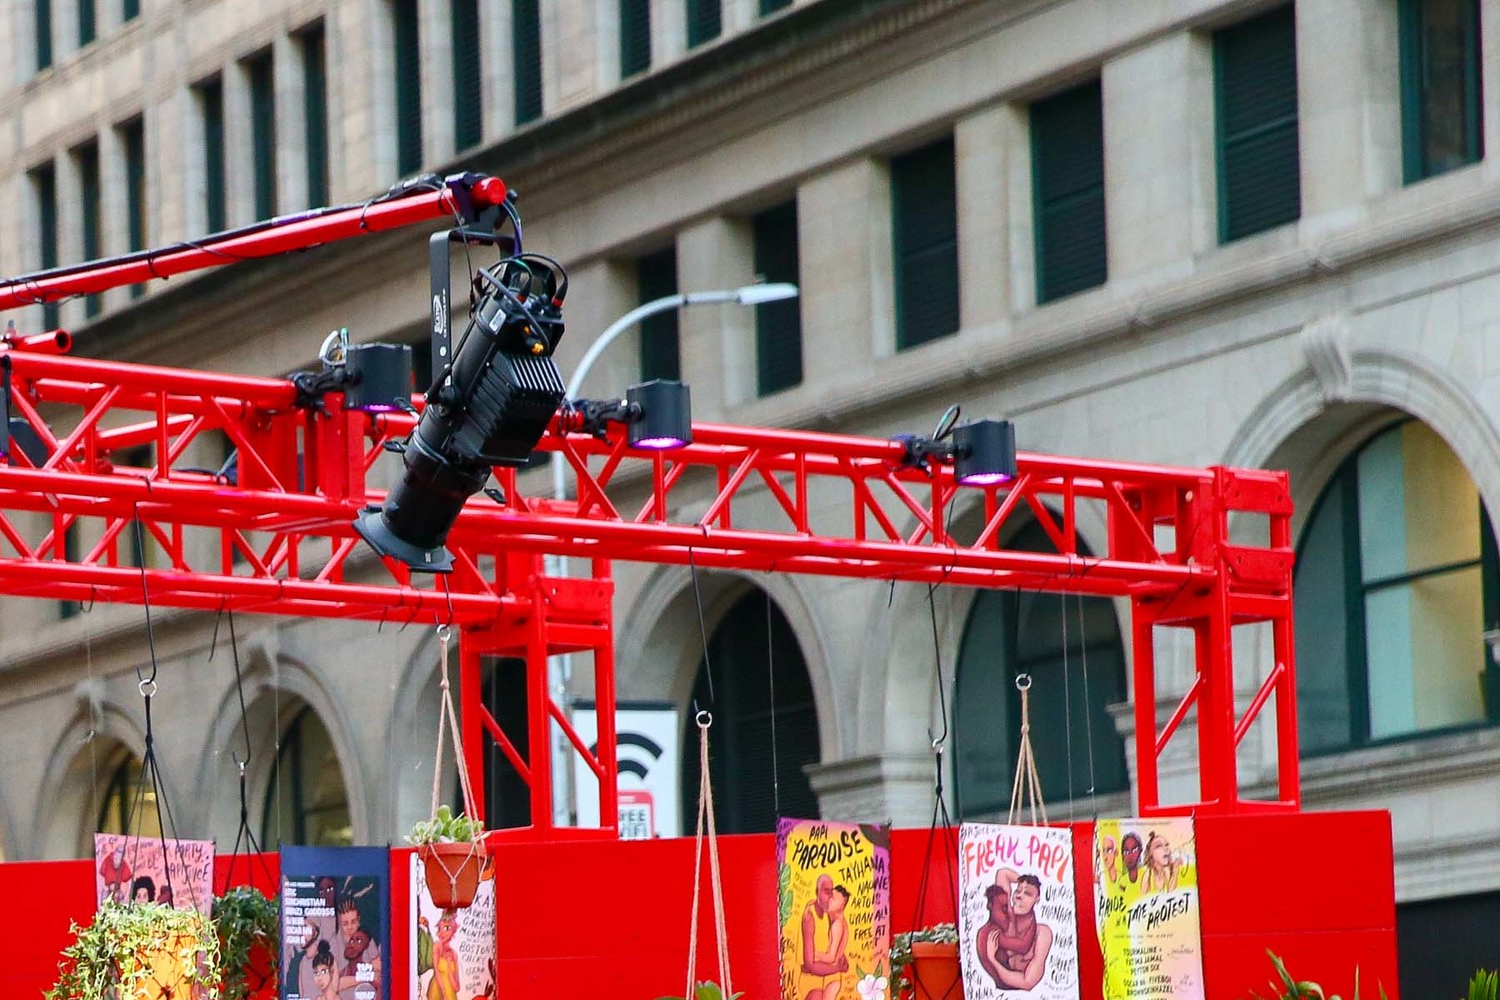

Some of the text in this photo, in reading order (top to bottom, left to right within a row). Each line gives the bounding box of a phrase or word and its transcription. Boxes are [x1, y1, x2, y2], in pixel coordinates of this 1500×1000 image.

[618, 809, 647, 821] REE
[809, 825, 828, 841] PAPI
[792, 830, 864, 871] PARADISE
[964, 834, 1070, 885] FREAK PAPI
[838, 855, 886, 883] TAYHANA
[1098, 896, 1127, 917] PRIDE
[1147, 892, 1191, 931] PROTEST
